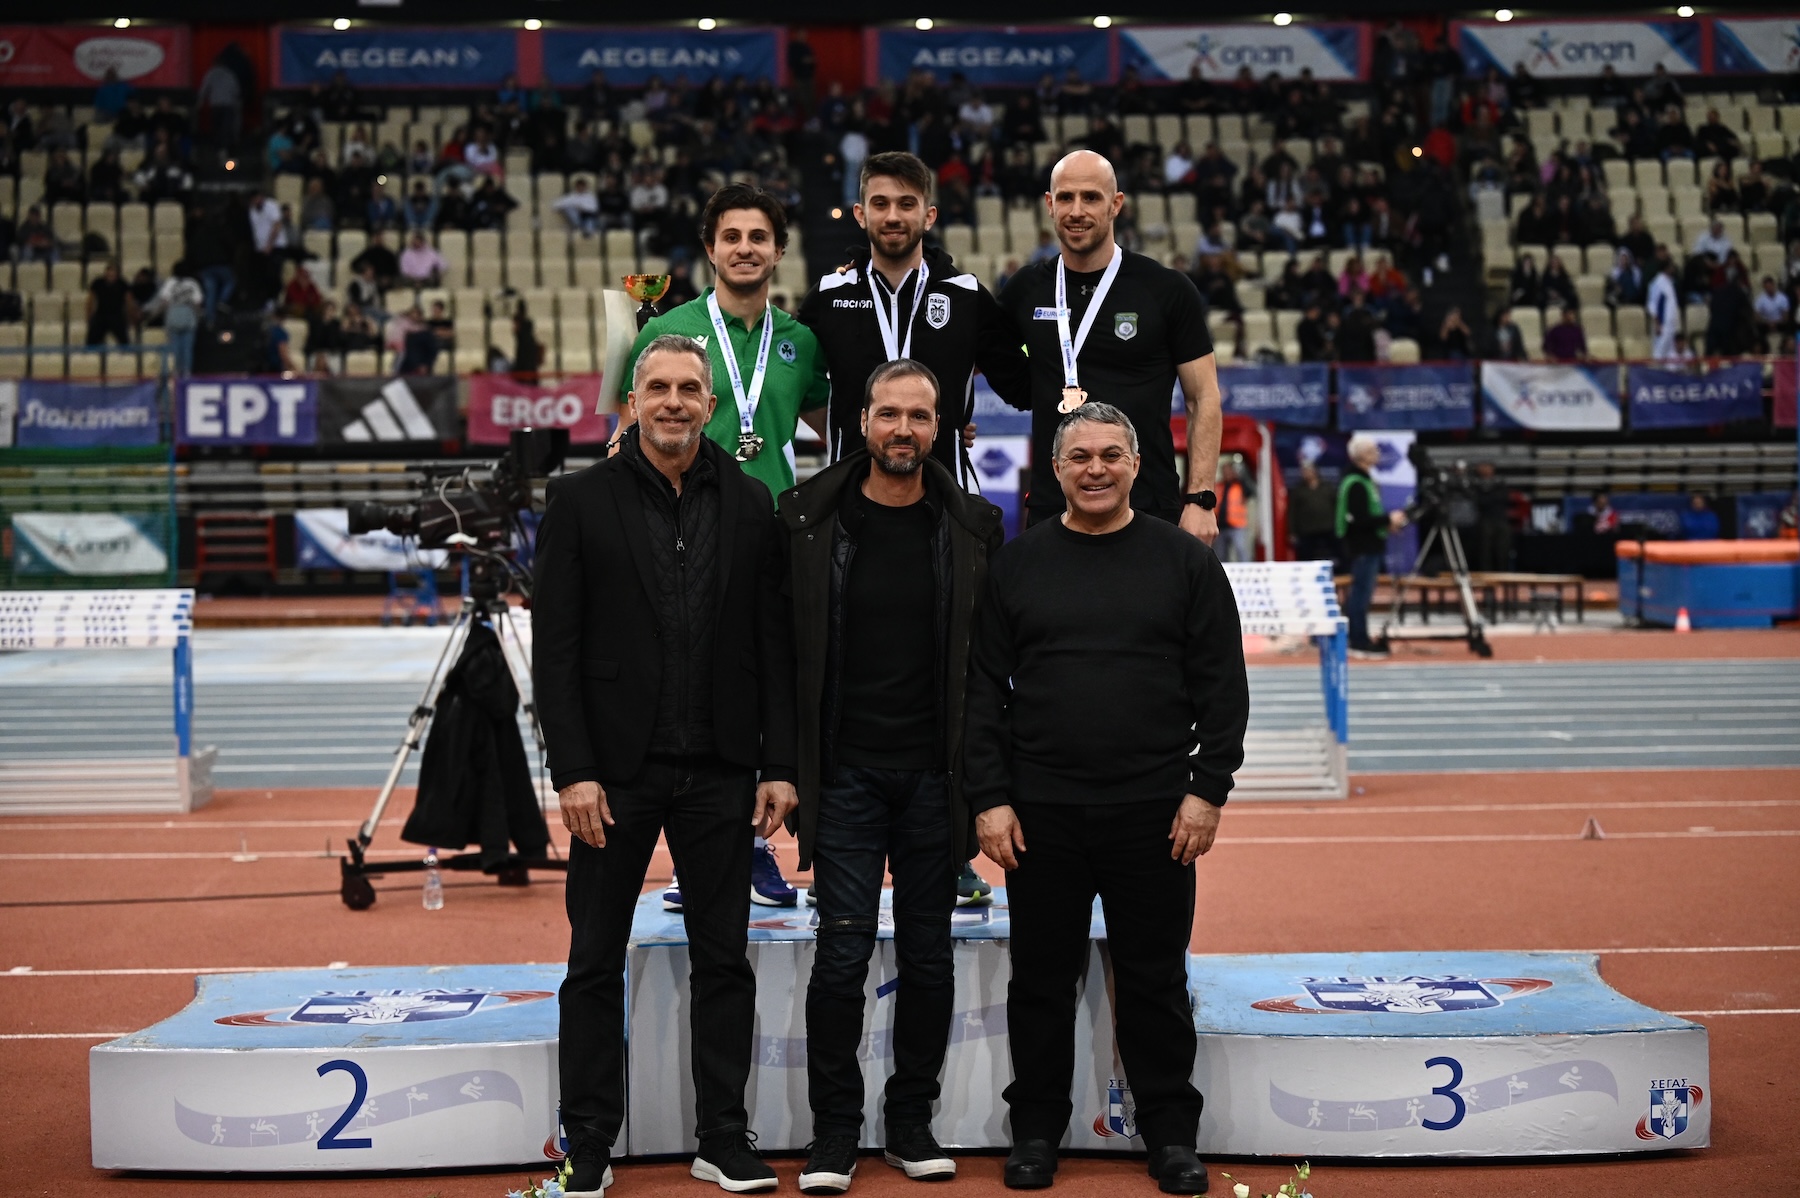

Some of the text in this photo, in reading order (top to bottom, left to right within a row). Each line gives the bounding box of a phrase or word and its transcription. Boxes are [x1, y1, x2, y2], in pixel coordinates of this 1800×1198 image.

[316, 48, 459, 67] AEGEAN
[578, 48, 720, 67] AEGEAN
[912, 47, 1055, 67] AEGEAN
[832, 298, 873, 309] macron
[1635, 383, 1737, 404] AEGEAN
[492, 392, 584, 426] ERGO
[1421, 1055, 1466, 1132] 3
[1650, 1078, 1689, 1090] ΣΕΓΑΣ
[316, 1059, 373, 1149] 2
